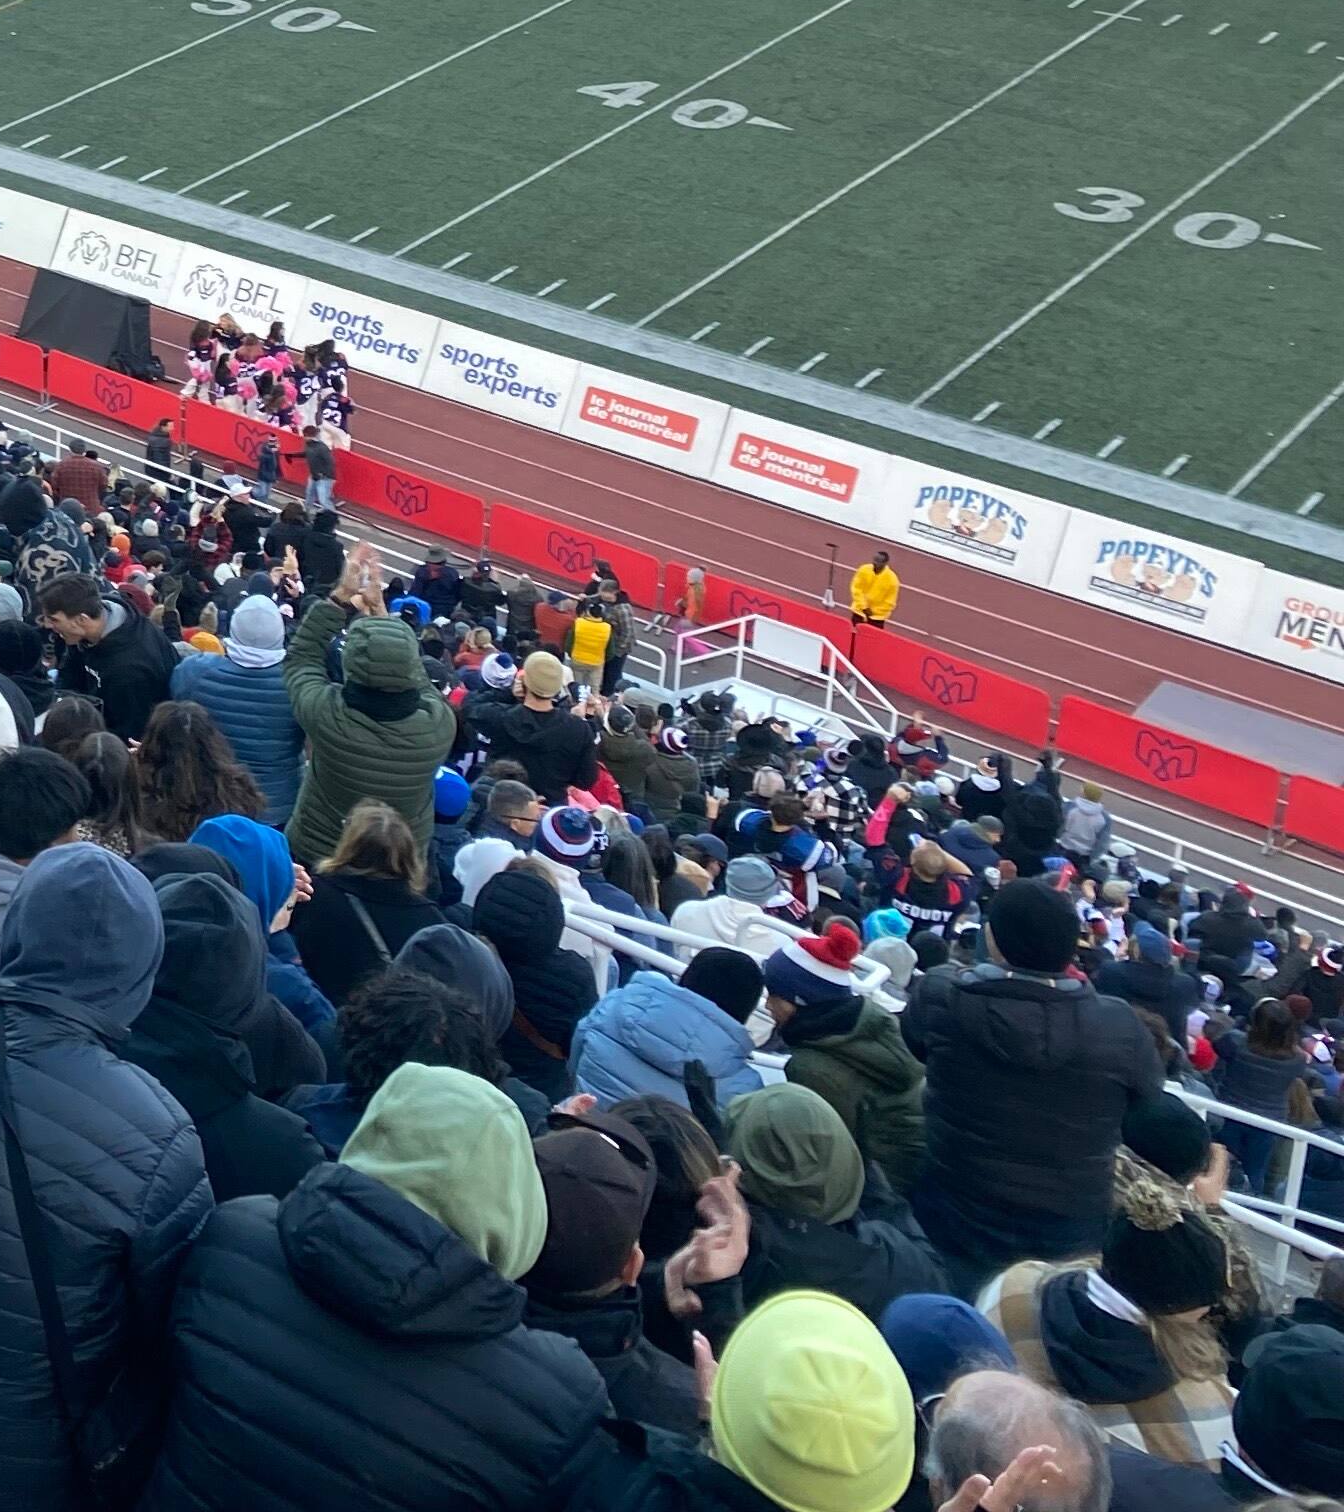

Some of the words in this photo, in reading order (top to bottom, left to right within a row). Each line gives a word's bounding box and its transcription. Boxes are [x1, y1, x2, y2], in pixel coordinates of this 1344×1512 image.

[575, 80, 750, 129] 40
[1053, 186, 1262, 249] 30
[111, 267, 160, 289] CANADA
[115, 243, 163, 278] BFL
[235, 277, 285, 314] BFL
[309, 300, 384, 335] sports
[332, 324, 420, 364] experts
[440, 342, 519, 379] sports
[463, 367, 559, 409] experts
[587, 406, 608, 419] de
[611, 414, 689, 444] montréal
[590, 394, 606, 407] le
[608, 398, 668, 426] journal
[738, 453, 762, 468] de
[764, 462, 848, 495] montréal
[741, 440, 759, 454] le
[760, 446, 826, 476] journal
[915, 485, 1028, 541] POPEYE'S
[1096, 540, 1218, 599] POPEYE'S
